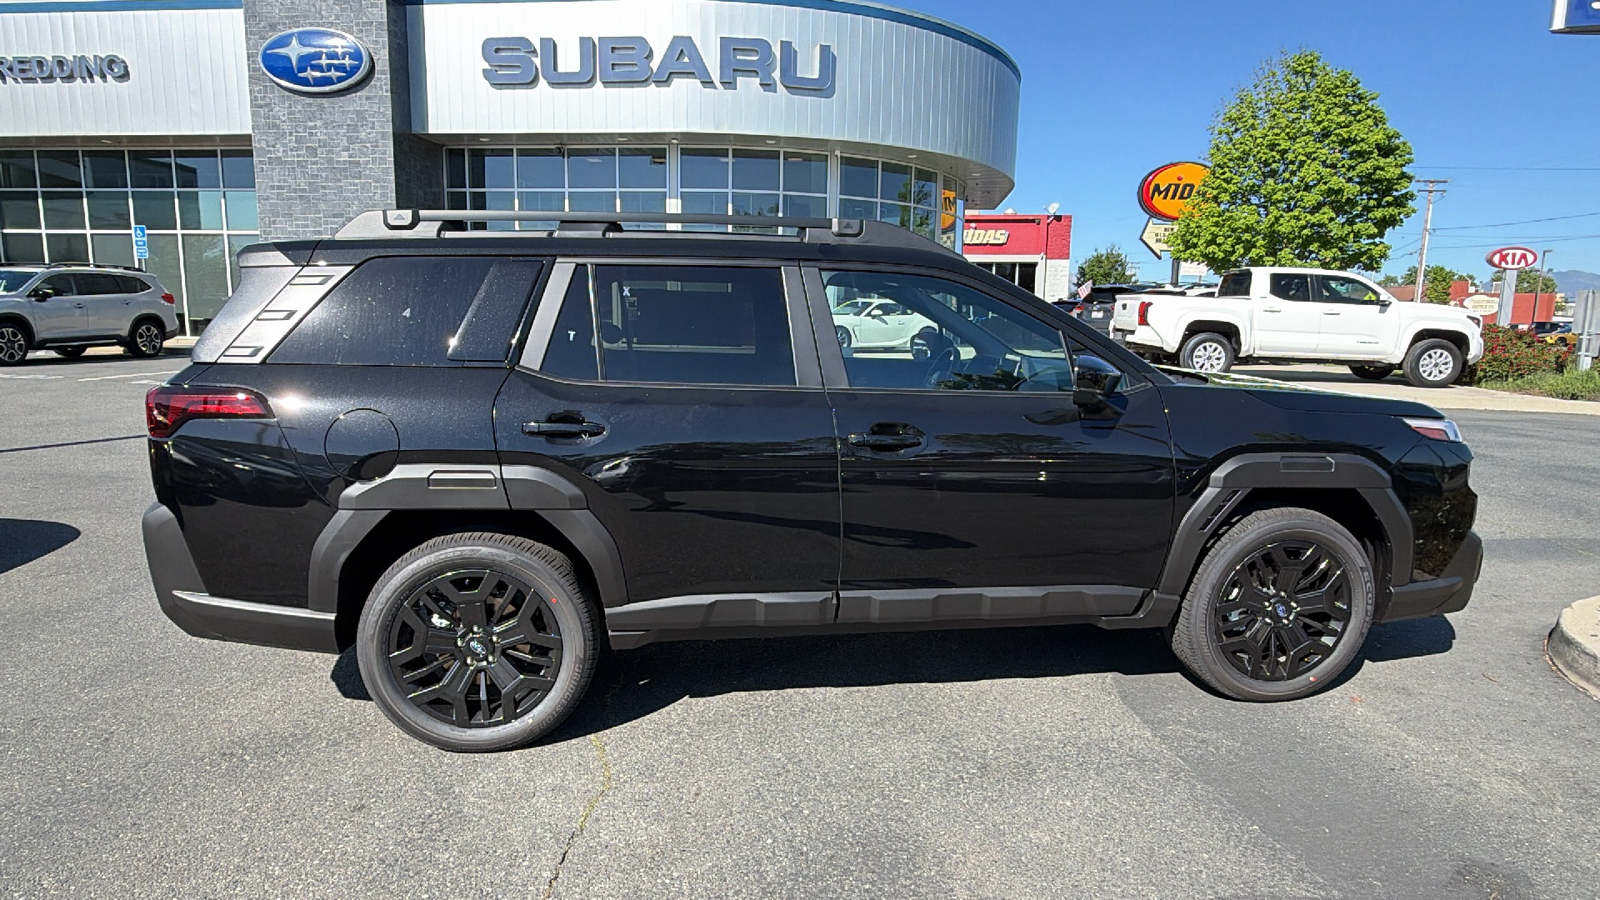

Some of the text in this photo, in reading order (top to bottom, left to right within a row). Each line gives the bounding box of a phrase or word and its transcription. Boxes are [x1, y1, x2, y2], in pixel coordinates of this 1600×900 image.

[0, 55, 128, 81] REDDING
[481, 36, 834, 93] SUBARU
[1151, 183, 1208, 201] MID
[1497, 252, 1529, 267] KIA
